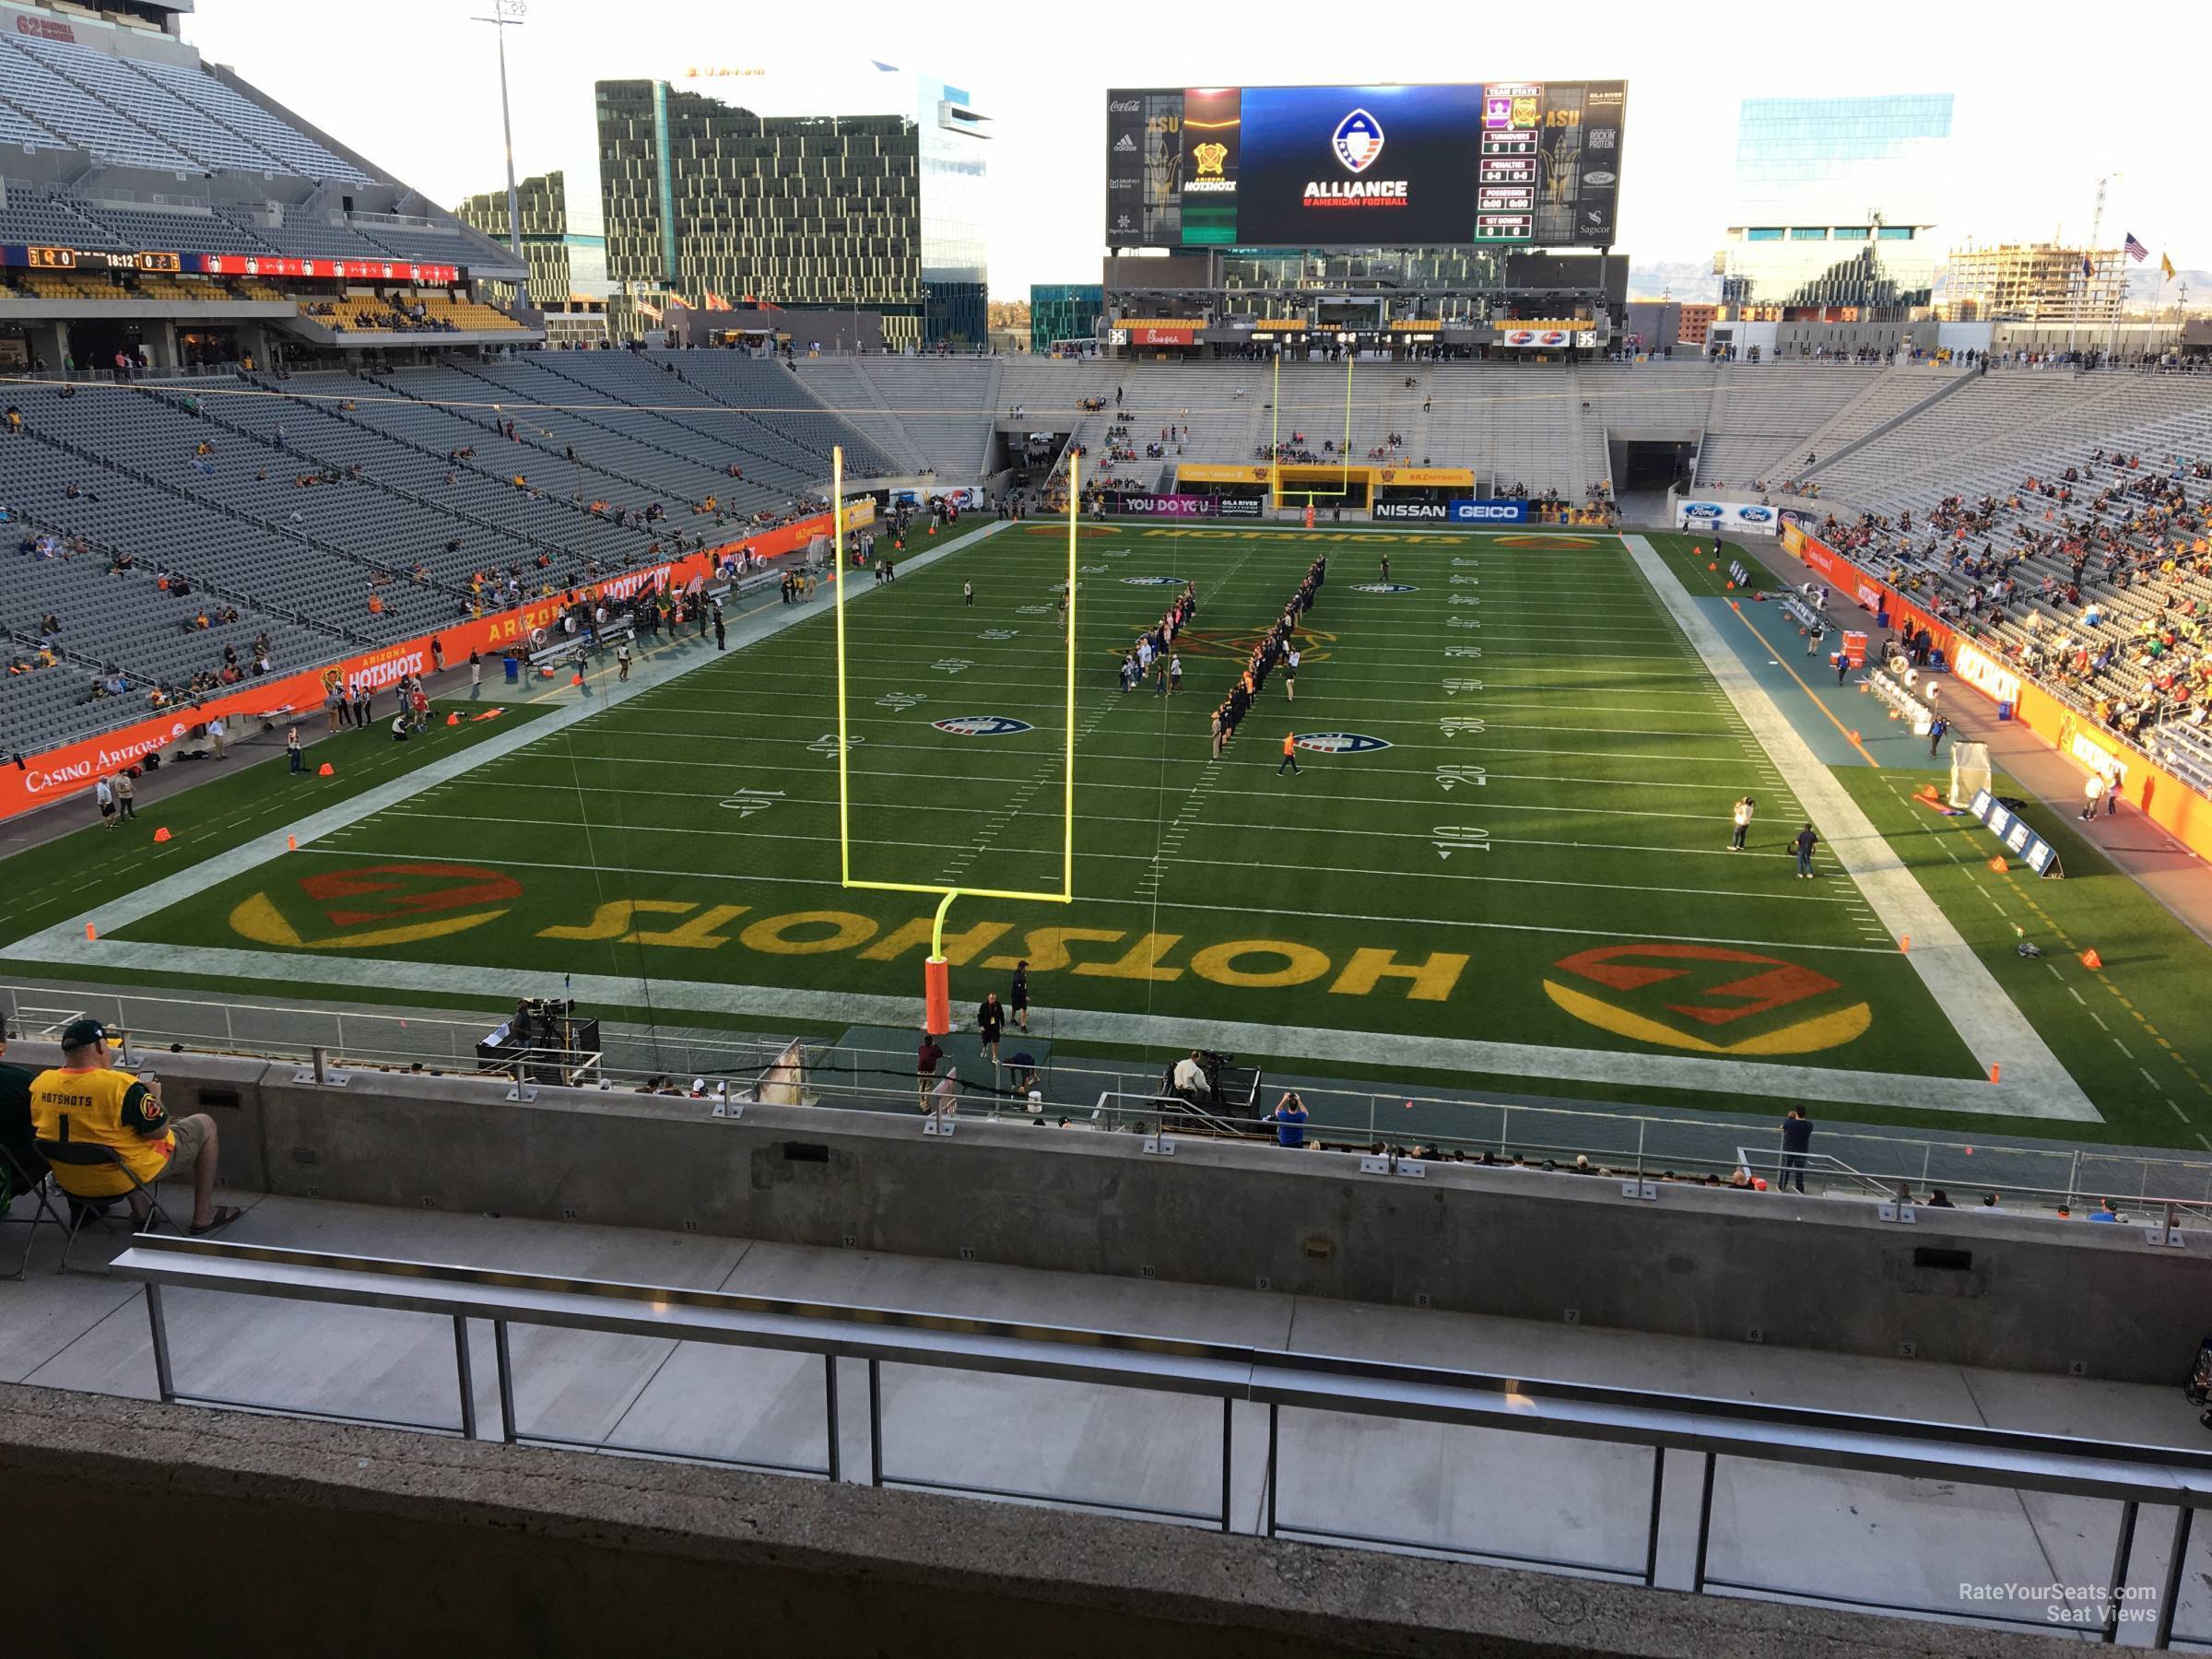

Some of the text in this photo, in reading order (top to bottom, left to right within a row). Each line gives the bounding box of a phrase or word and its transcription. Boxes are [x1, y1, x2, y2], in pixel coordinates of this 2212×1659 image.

[17, 15, 41, 36] 62
[1147, 116, 1179, 133] ASU
[1546, 110, 1580, 127] ASU
[1492, 143, 1500, 152] 0
[1519, 143, 1525, 151] 0
[1589, 140, 1614, 148] PROTEIN
[1487, 171, 1501, 180] 0-0
[1513, 171, 1527, 180] 0-0
[1184, 182, 1237, 192] HOTSHOTS
[1303, 181, 1407, 198] ALLIANCE
[1486, 189, 1526, 197] POSSESSION
[1312, 197, 1360, 206] AMERICAN
[1362, 197, 1407, 206] FOOTBALL
[1483, 199, 1501, 208] 0:00
[1509, 199, 1528, 208] 0:00
[1487, 227, 1494, 236] 0
[1512, 227, 1520, 235] 0
[1580, 224, 1610, 236] Sagicor
[31, 254, 37, 265] 3
[62, 251, 69, 265] 0
[106, 253, 134, 268] 18:12
[146, 254, 152, 268] 0
[1112, 330, 1124, 343] 35
[1579, 333, 1594, 346] 35
[1126, 498, 1209, 513] YOU DO YOU
[1376, 504, 1446, 517] NISSAN
[1459, 505, 1519, 518] GEICO
[1691, 505, 1716, 517] Ford
[1744, 509, 1767, 522] Ford
[1141, 529, 1471, 544] HOTSHOTS
[362, 647, 406, 667] ARIZONA
[1444, 646, 1482, 658] 50
[349, 651, 424, 695] HOTSHOTS
[1955, 643, 2021, 708] HOTSHOTS
[1441, 677, 1483, 692] 40
[1440, 716, 1486, 734] 30
[25, 760, 91, 793] CASINO
[1435, 764, 1487, 786] 20
[719, 787, 787, 810] 10
[1431, 826, 1490, 852] 10
[536, 898, 1471, 1003] HOTSHOTS
[41, 1091, 93, 1107] HOTSHOTS
[59, 1113, 69, 1144] 1
